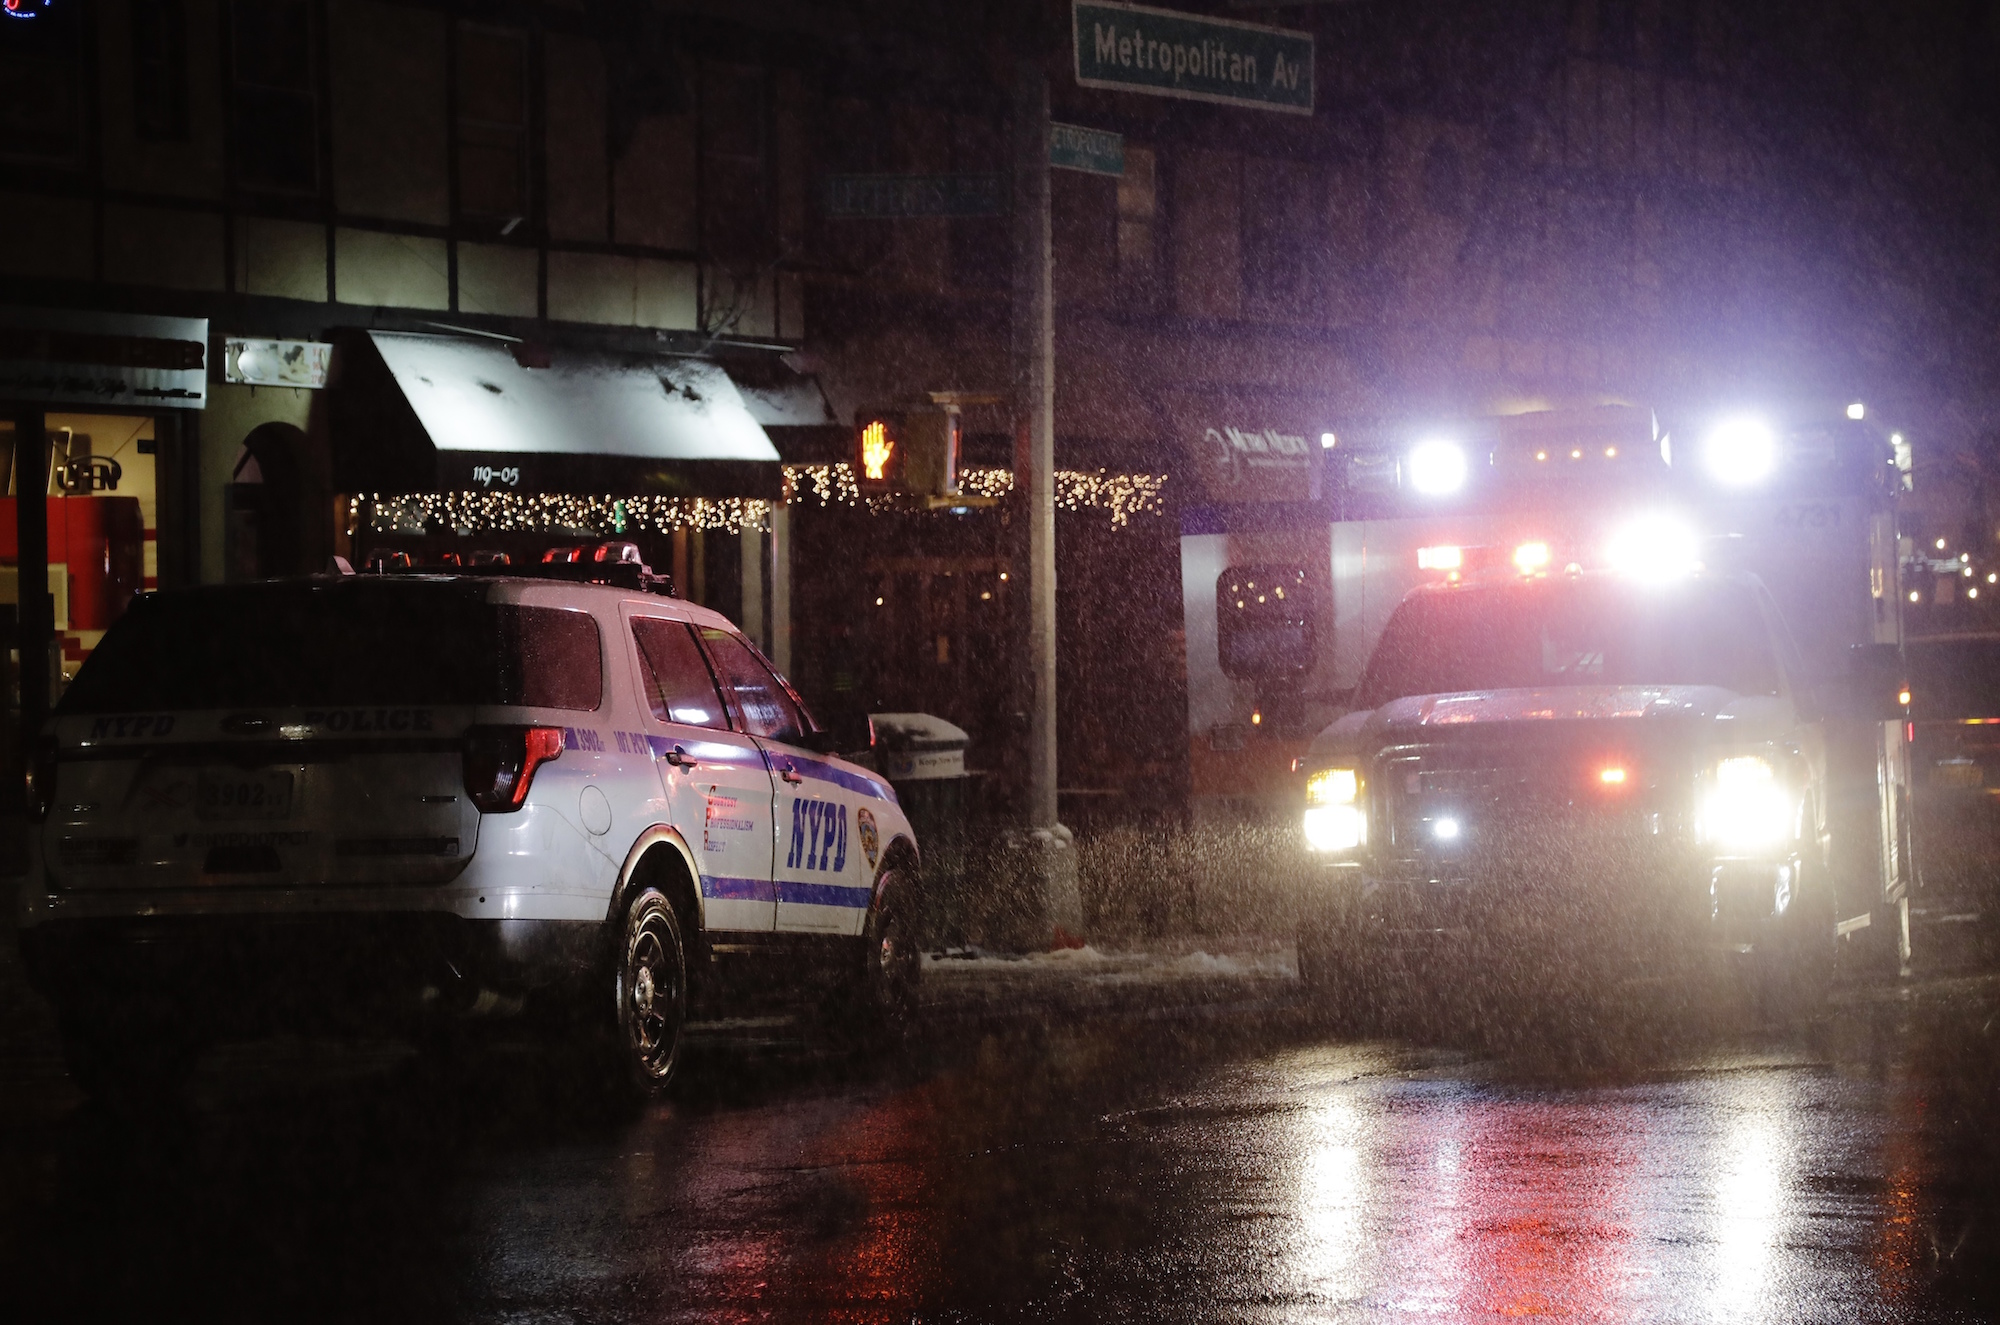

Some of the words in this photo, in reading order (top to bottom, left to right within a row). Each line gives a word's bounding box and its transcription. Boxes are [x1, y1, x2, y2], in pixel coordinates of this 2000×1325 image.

[1094, 22, 1258, 84] Metropolitan
[1272, 51, 1300, 90] Av
[472, 465, 520, 488] 119-05
[90, 715, 175, 739] NYPD
[304, 709, 434, 733] POLICE
[205, 783, 265, 806] 3902
[787, 798, 848, 873] NYPD
